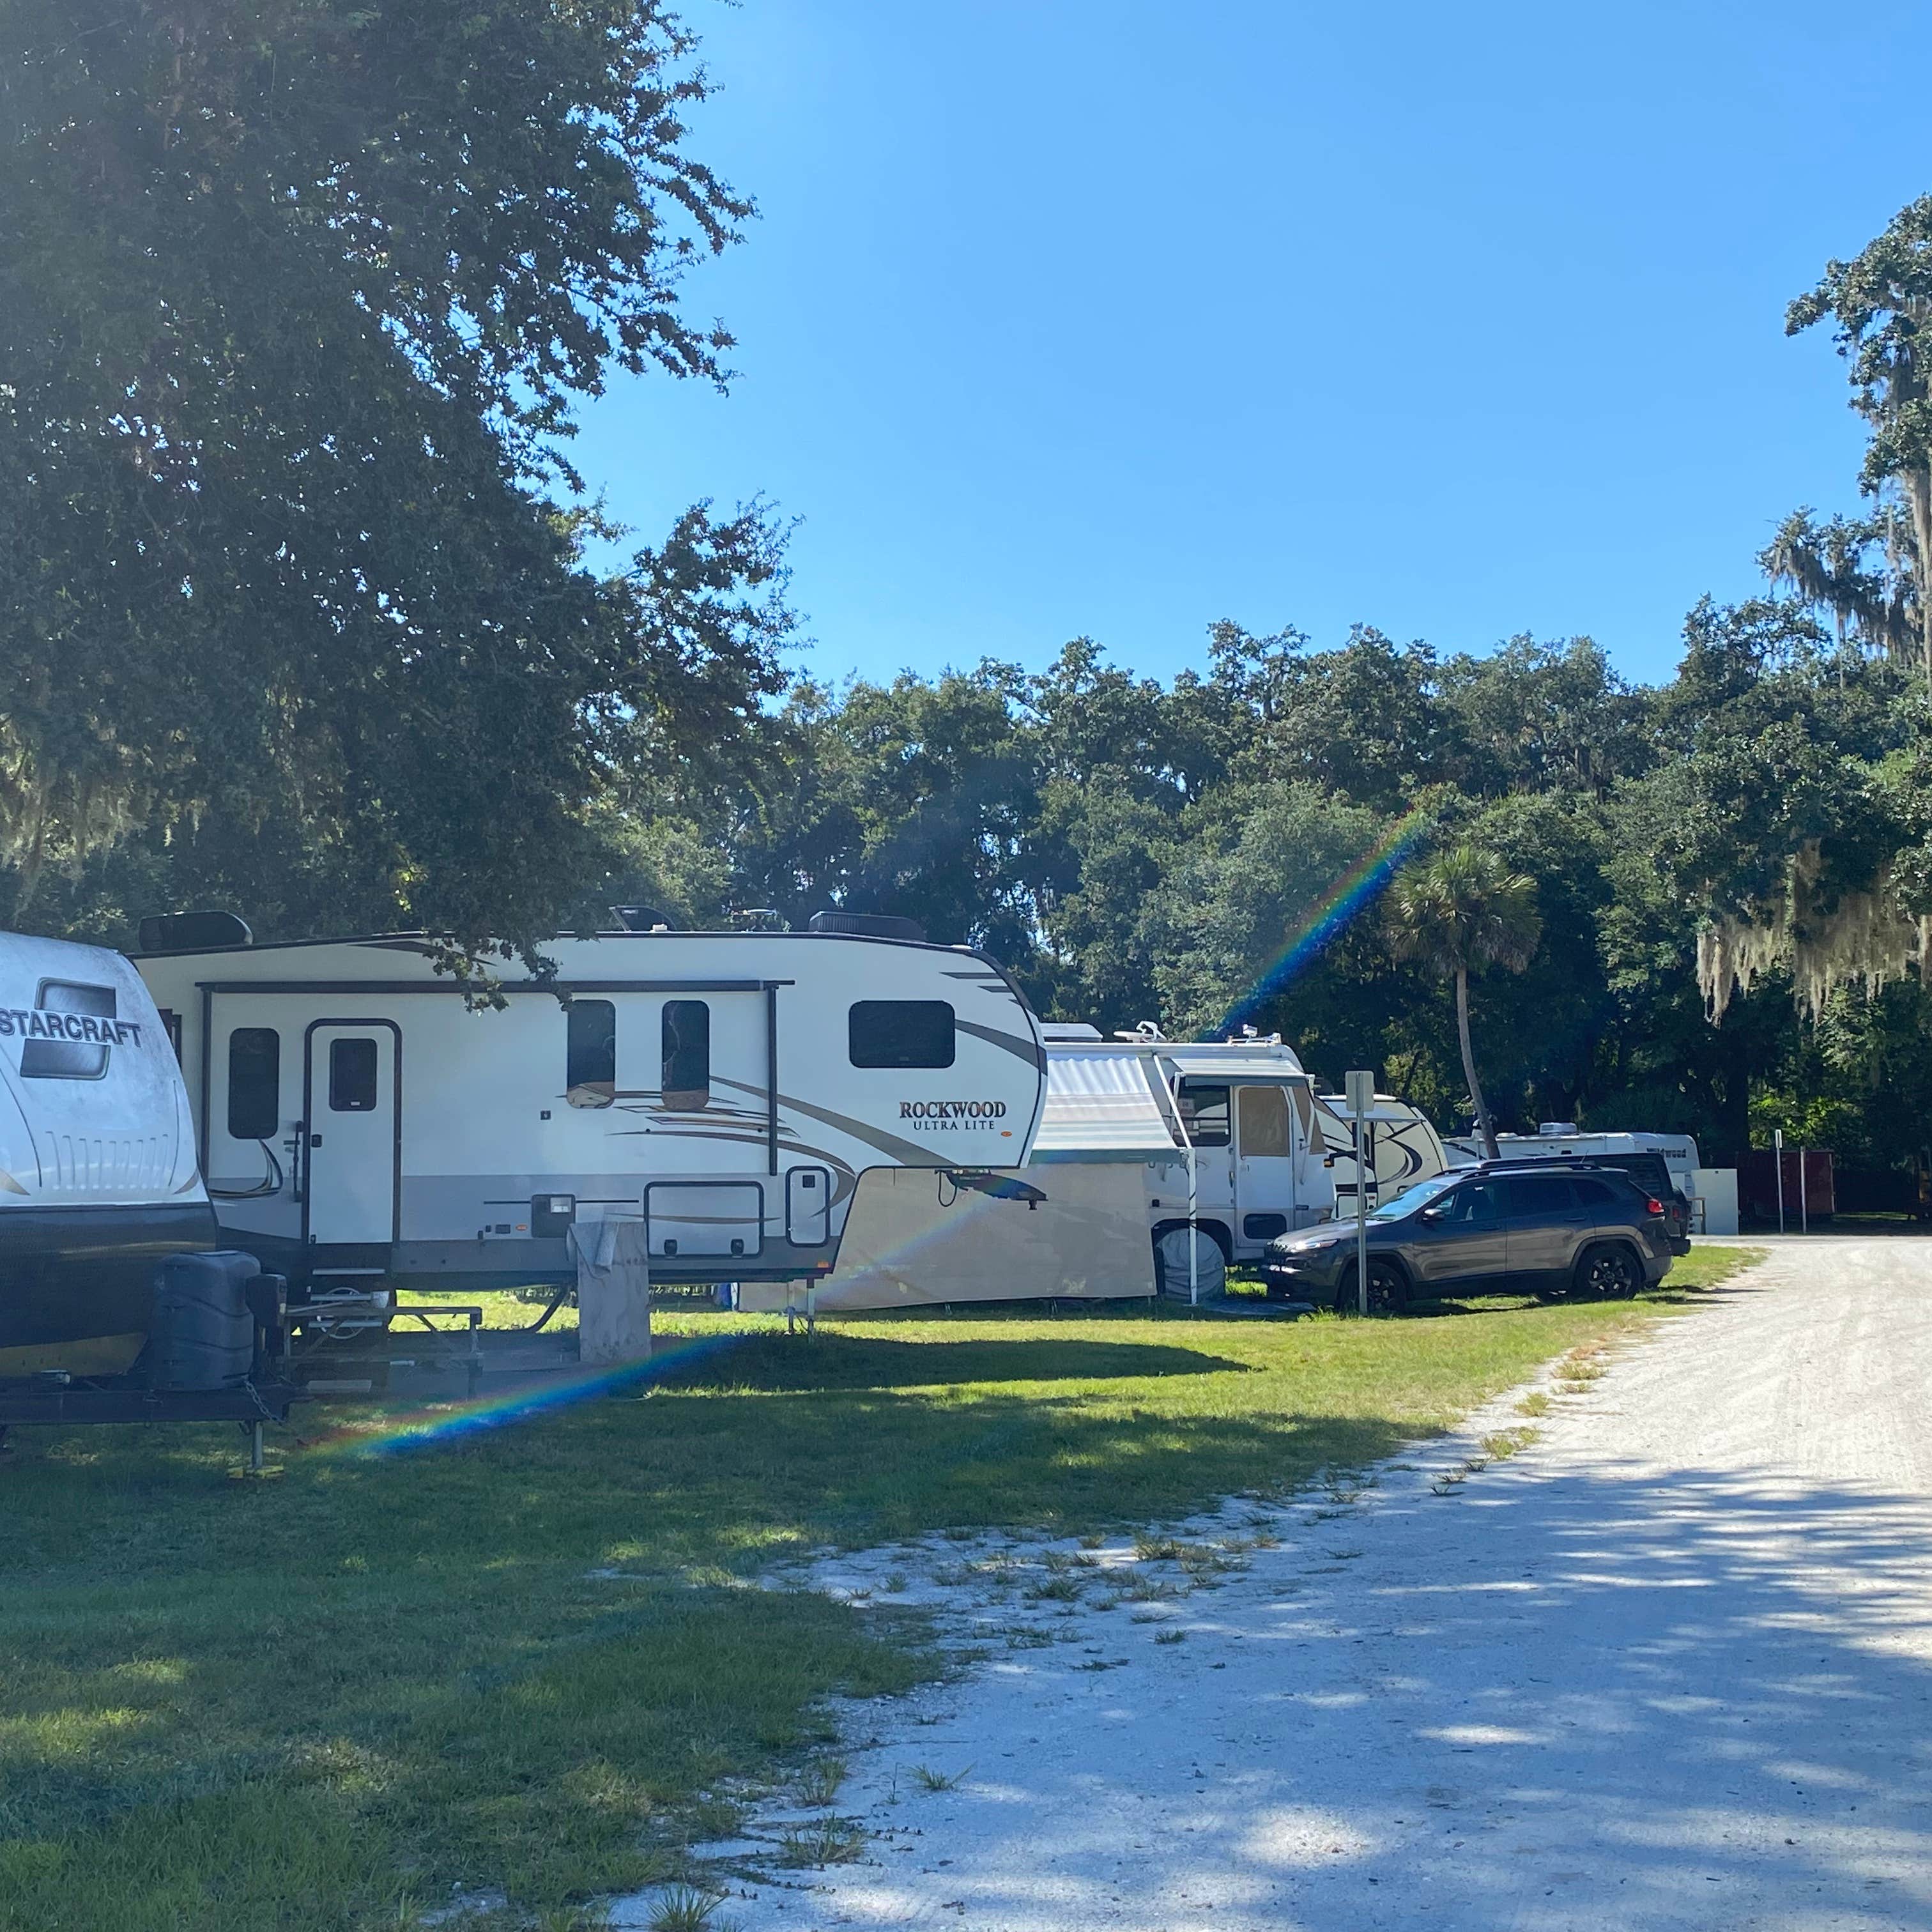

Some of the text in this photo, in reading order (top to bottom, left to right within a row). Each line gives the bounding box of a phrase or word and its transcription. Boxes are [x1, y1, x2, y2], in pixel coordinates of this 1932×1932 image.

[0, 1008, 141, 1048] STARCRAFT
[900, 1101, 1006, 1118] ROCKWOOD
[914, 1121, 995, 1130] ULTRA LITE
